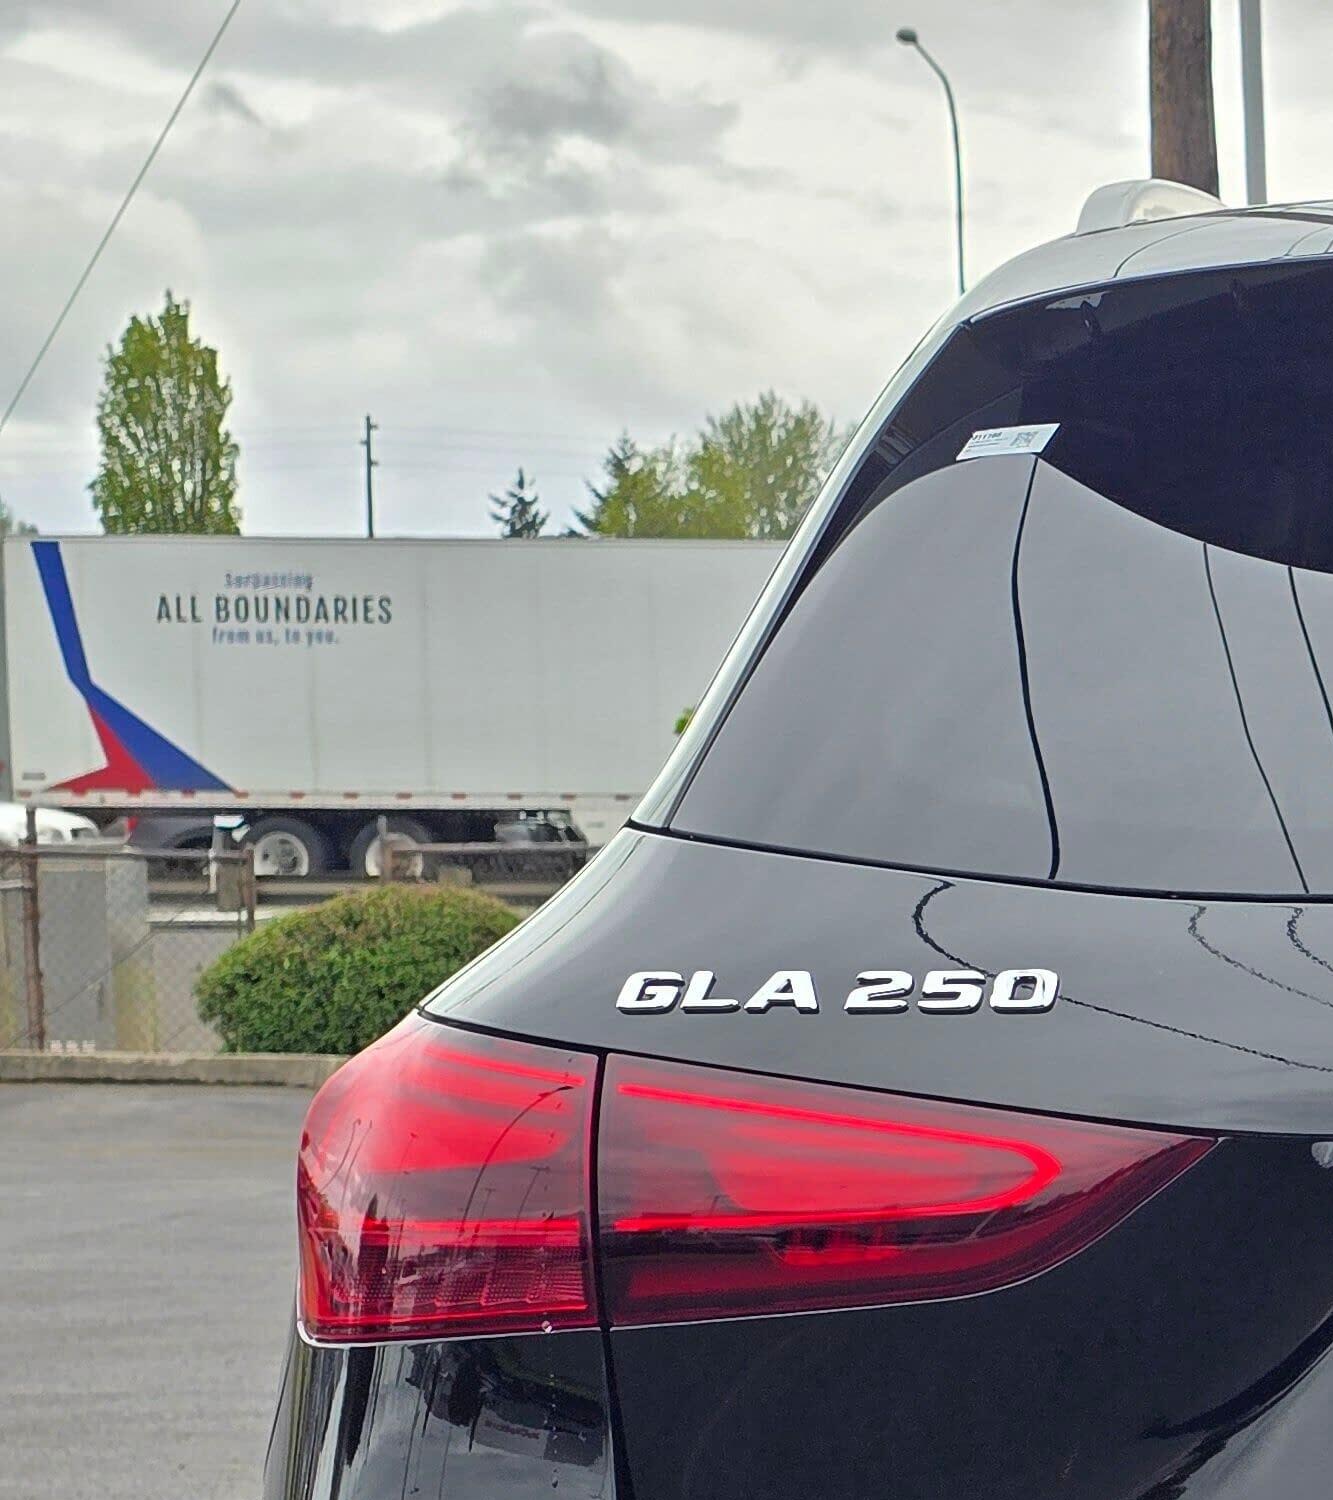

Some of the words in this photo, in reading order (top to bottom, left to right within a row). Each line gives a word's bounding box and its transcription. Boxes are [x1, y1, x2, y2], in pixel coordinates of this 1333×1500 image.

[156, 594, 202, 623] ALL
[215, 594, 393, 624] BOUNDARIES
[212, 626, 250, 644] from
[615, 969, 820, 1015] GLA
[843, 968, 1059, 1015] 250
